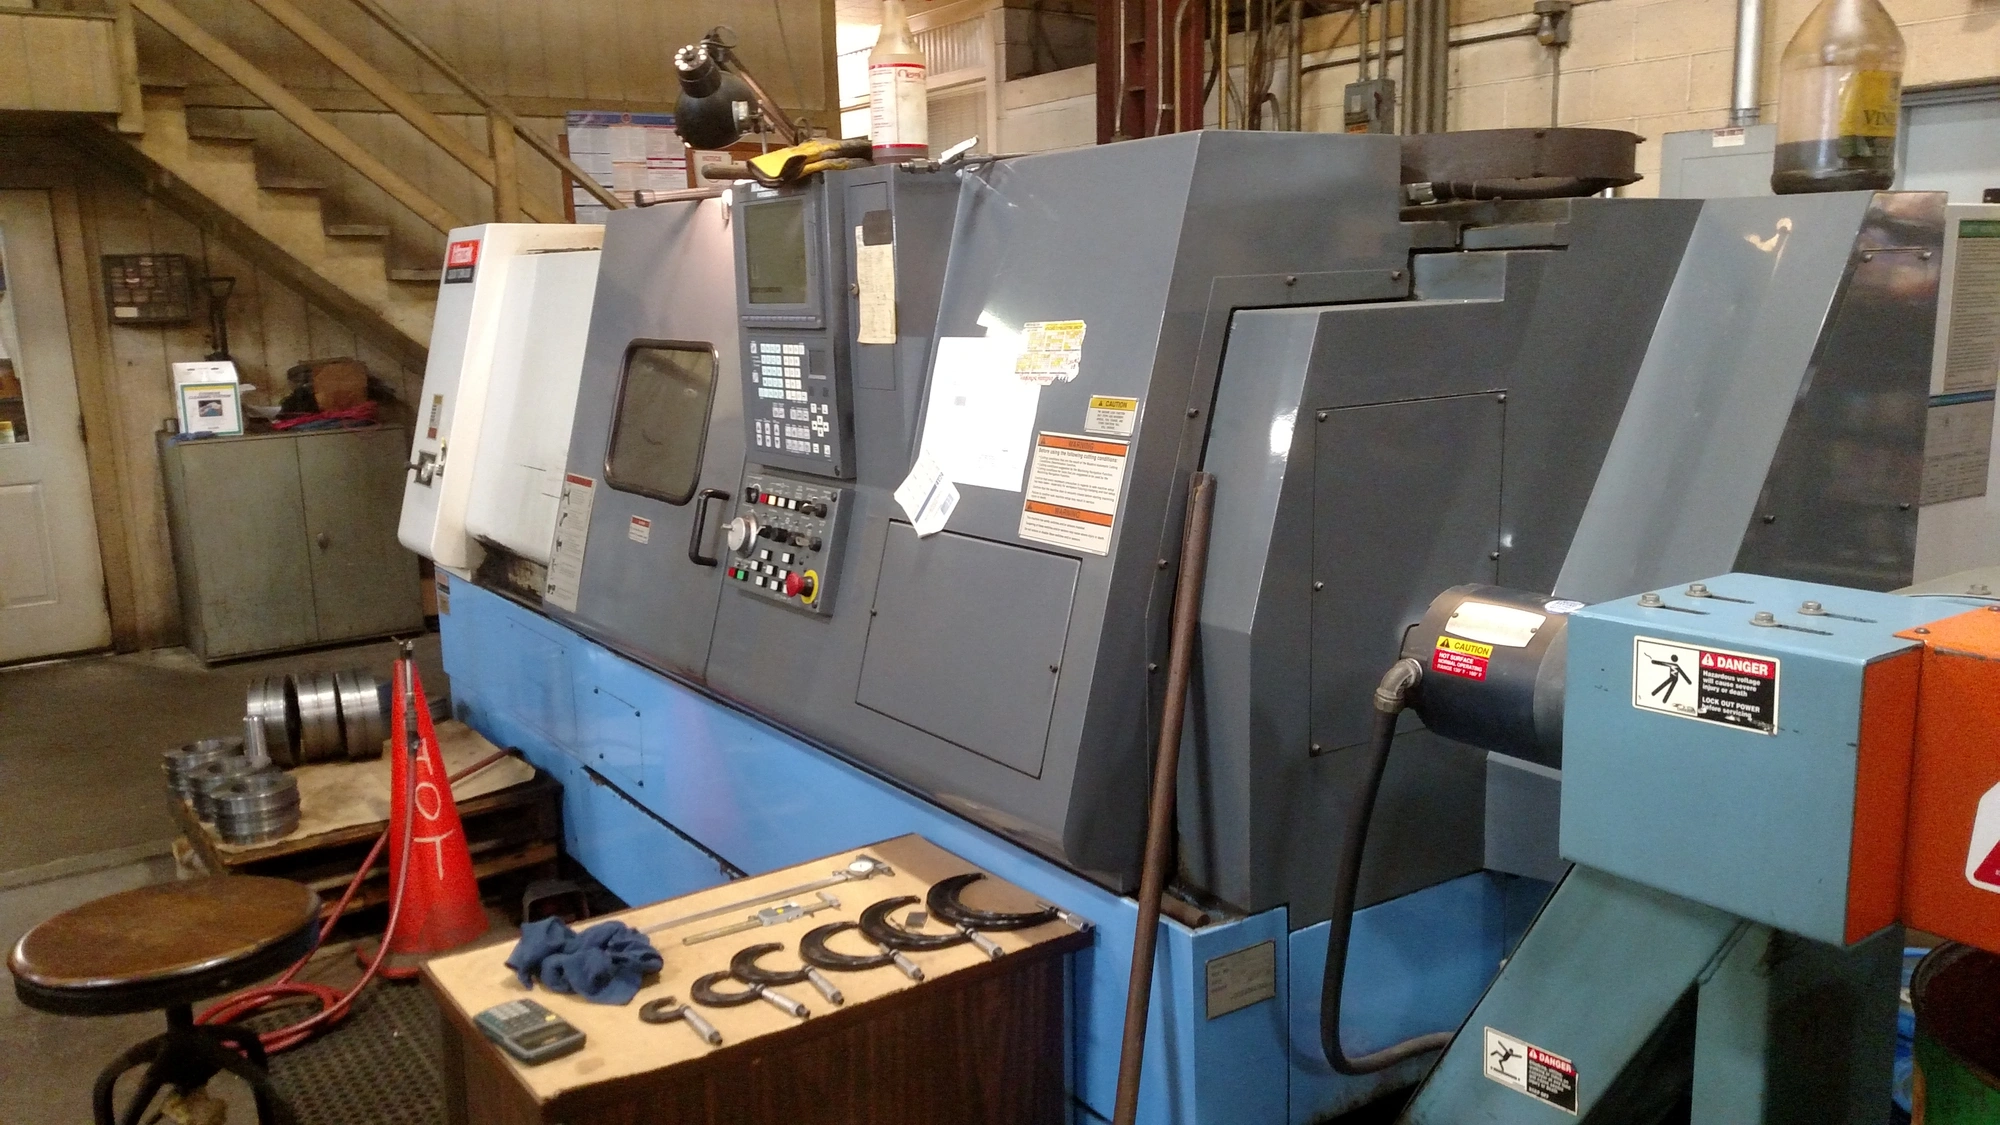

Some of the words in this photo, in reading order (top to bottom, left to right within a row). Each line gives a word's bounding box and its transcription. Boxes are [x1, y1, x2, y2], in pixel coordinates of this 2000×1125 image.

[1105, 400, 1128, 409] CAUTION
[1068, 440, 1094, 451] WARNING
[1067, 451, 1083, 460] following
[1084, 453, 1097, 462] cutting
[1054, 507, 1080, 519] WARNING
[1454, 642, 1490, 656] CAUTION
[1437, 658, 1456, 666] NORMAL
[1456, 662, 1483, 672] OPERATING
[1450, 654, 1474, 665] SURFACE
[1717, 656, 1769, 676] DANGER
[1703, 670, 1735, 681] Hazardous
[1736, 677, 1761, 686] voltage
[1702, 684, 1720, 693] injury
[1729, 688, 1748, 697] death
[1715, 680, 1734, 688] cause
[1735, 683, 1757, 692] severe
[1702, 696, 1720, 705] LOCK
[1720, 700, 1735, 708] OUT
[1736, 703, 1760, 713] POWER
[1702, 703, 1721, 712] before
[1722, 708, 1752, 719] servicing
[1539, 1053, 1571, 1073] DANGER
